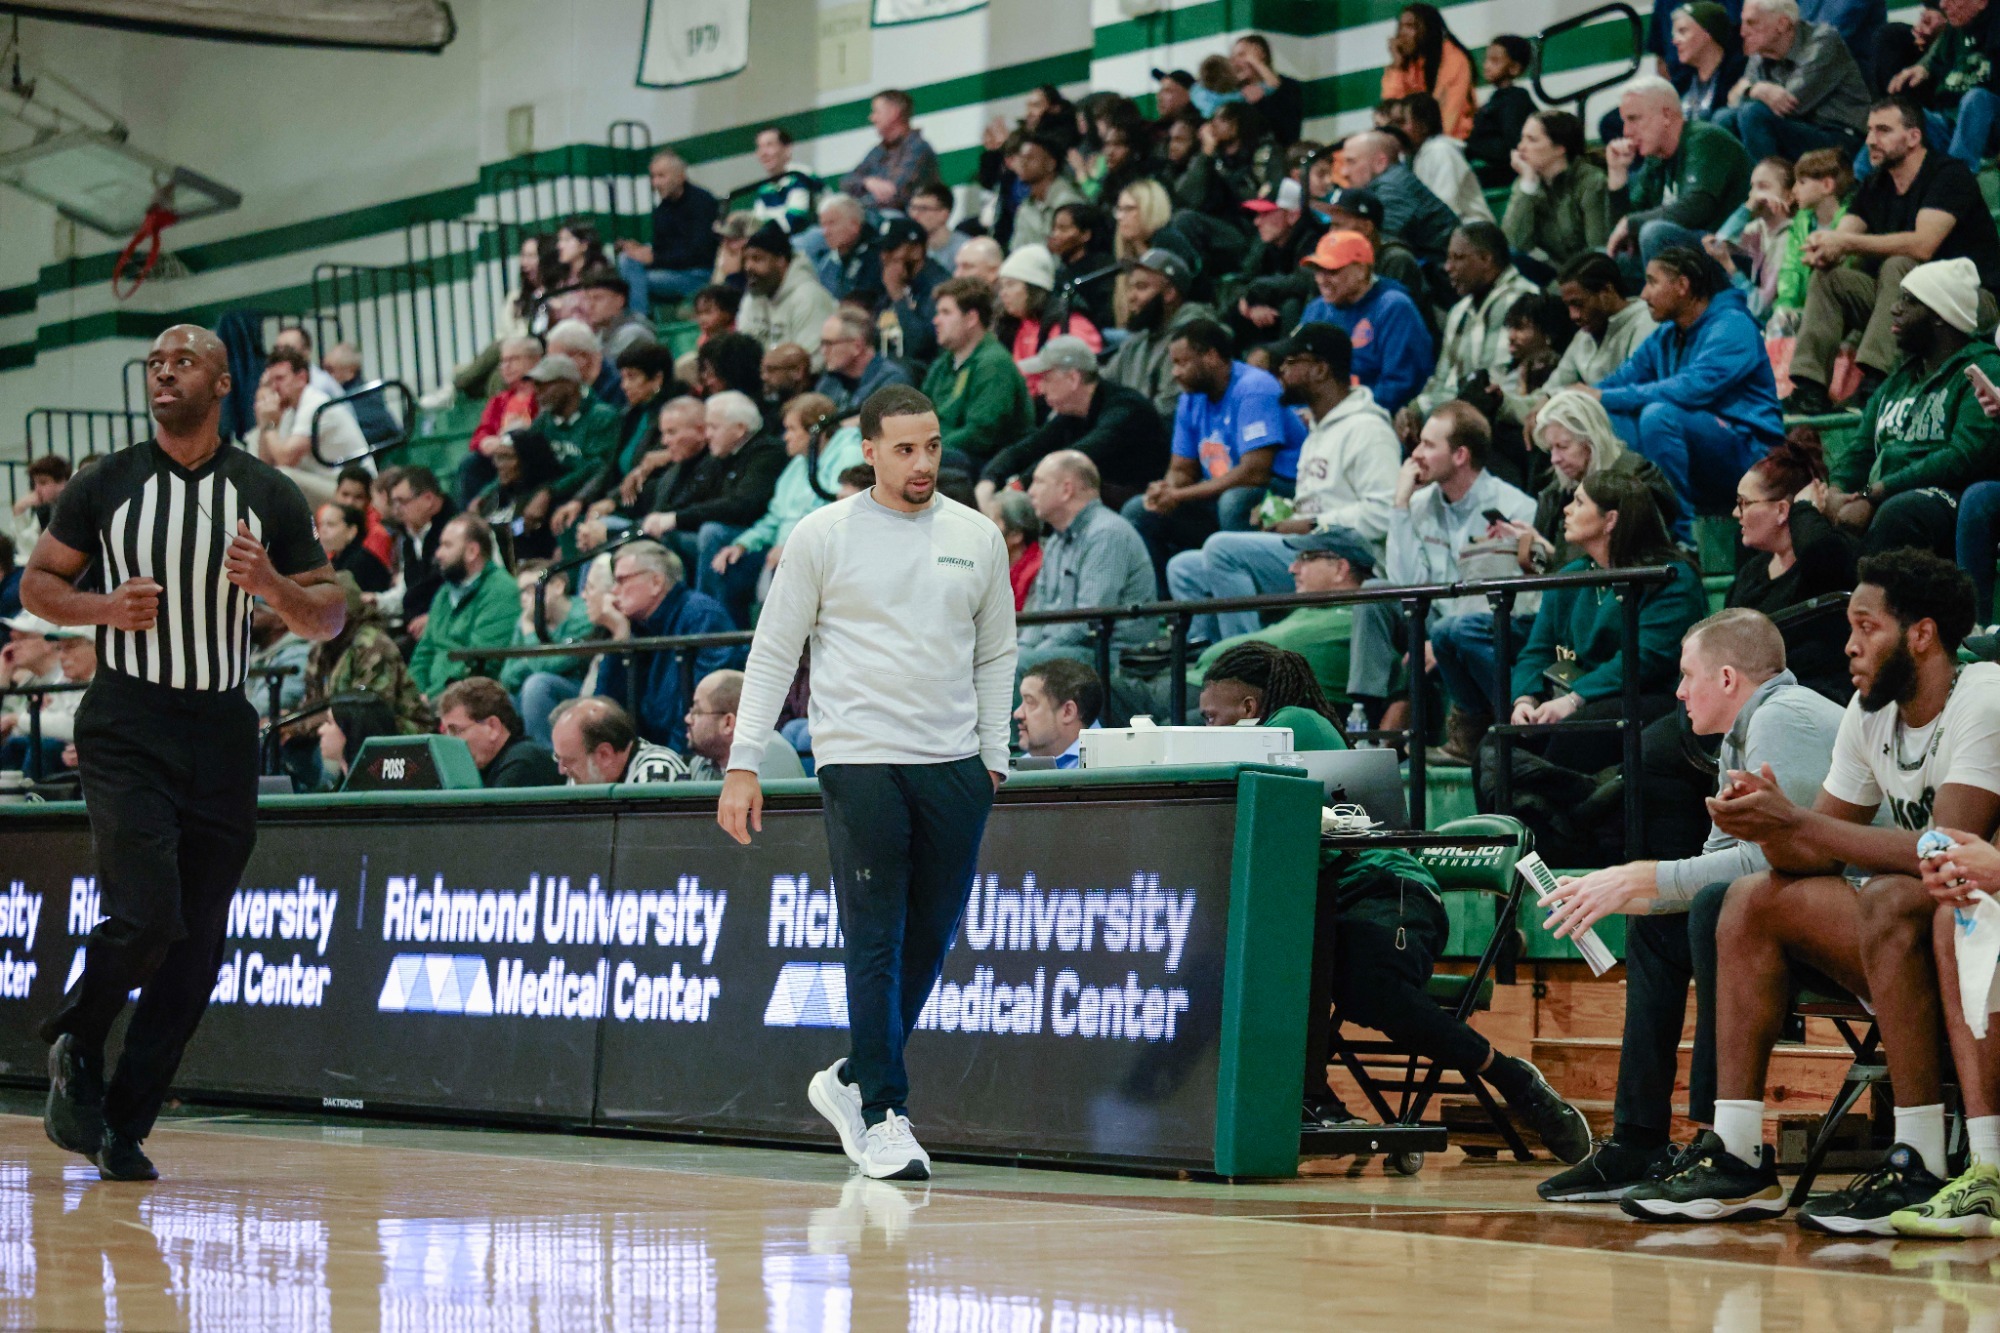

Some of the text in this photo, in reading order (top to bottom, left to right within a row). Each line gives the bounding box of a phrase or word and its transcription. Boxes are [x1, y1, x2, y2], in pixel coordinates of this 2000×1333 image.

[937, 556, 975, 568] WAGNER
[382, 757, 406, 780] POSS
[1418, 856, 1500, 867] SEAHAWKS
[383, 872, 727, 965] Richmond University
[966, 870, 1196, 974] University
[244, 951, 331, 1008] Center
[495, 956, 721, 1022] Medical Center
[1051, 967, 1190, 1043] Center
[323, 1097, 364, 1109] DAKTRONICS
